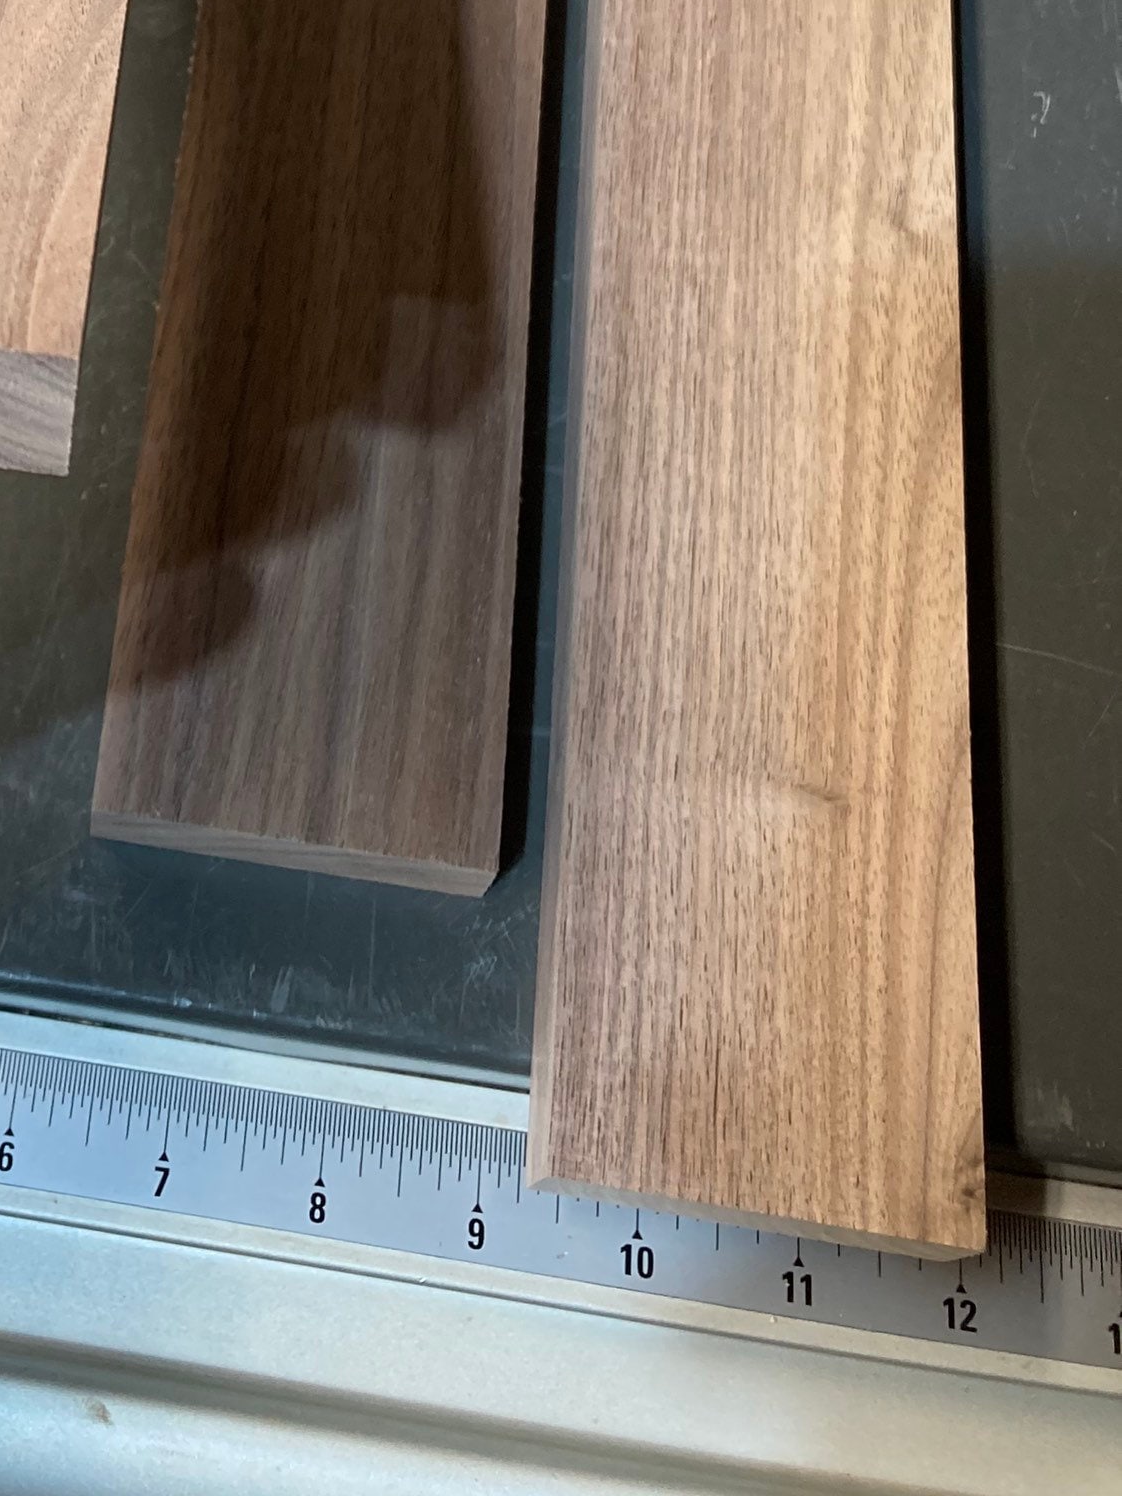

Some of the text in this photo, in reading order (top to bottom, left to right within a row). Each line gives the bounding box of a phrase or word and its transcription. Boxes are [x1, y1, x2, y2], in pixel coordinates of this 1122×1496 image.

[154, 1166, 170, 1197] 7
[309, 1192, 327, 1224] 8
[467, 1218, 485, 1250] 9
[620, 1243, 654, 1279] 10
[782, 1271, 813, 1307] 11
[942, 1297, 978, 1333] 12
[1108, 1322, 1122, 1355] 1
